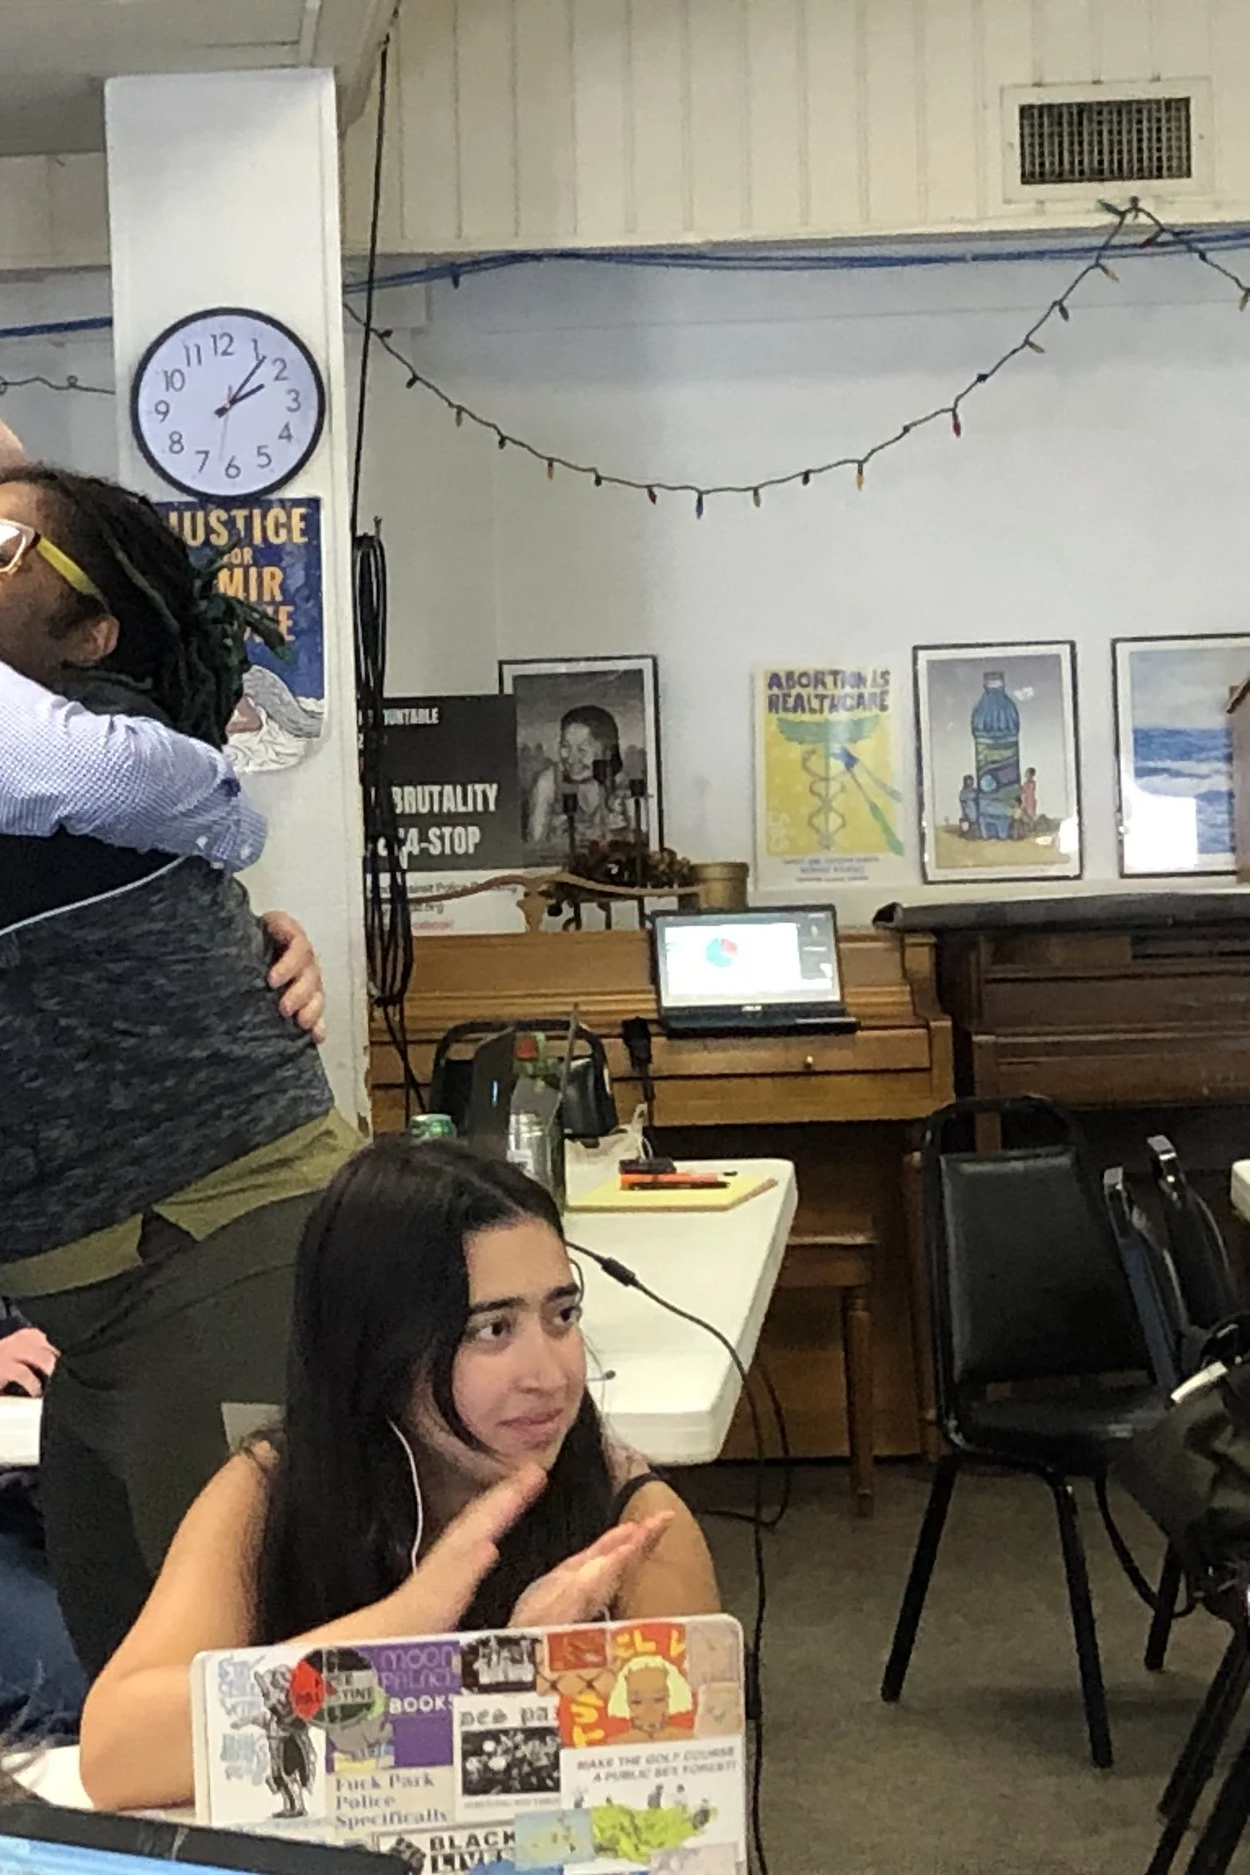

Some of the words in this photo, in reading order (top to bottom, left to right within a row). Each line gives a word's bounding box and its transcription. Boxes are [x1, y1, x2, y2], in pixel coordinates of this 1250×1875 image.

[184, 344, 202, 367] 11
[210, 332, 235, 356] 12
[252, 338, 262, 361] 1
[163, 368, 186, 392] 10
[272, 357, 288, 381] 2
[154, 400, 171, 423] 9
[286, 388, 301, 412] 3
[168, 431, 185, 454] 8
[278, 421, 294, 442] 4
[195, 450, 211, 473] 7
[224, 455, 241, 479] 6
[256, 445, 272, 468] 5
[216, 566, 284, 602] MIR
[768, 670, 867, 690] ABORTION
[870, 669, 891, 689] IS
[768, 689, 890, 714] HEALTHCARE
[391, 783, 499, 814] BRUTALITY
[398, 825, 482, 856] 4-STOP
[381, 1646, 455, 1670] MOON
[618, 1755, 642, 1767] THE
[335, 1776, 382, 1793] Fuck
[388, 1771, 435, 1789] Park
[335, 1795, 396, 1811] Police
[334, 1808, 449, 1830] Specifically
[430, 1829, 516, 1851] BLACK
